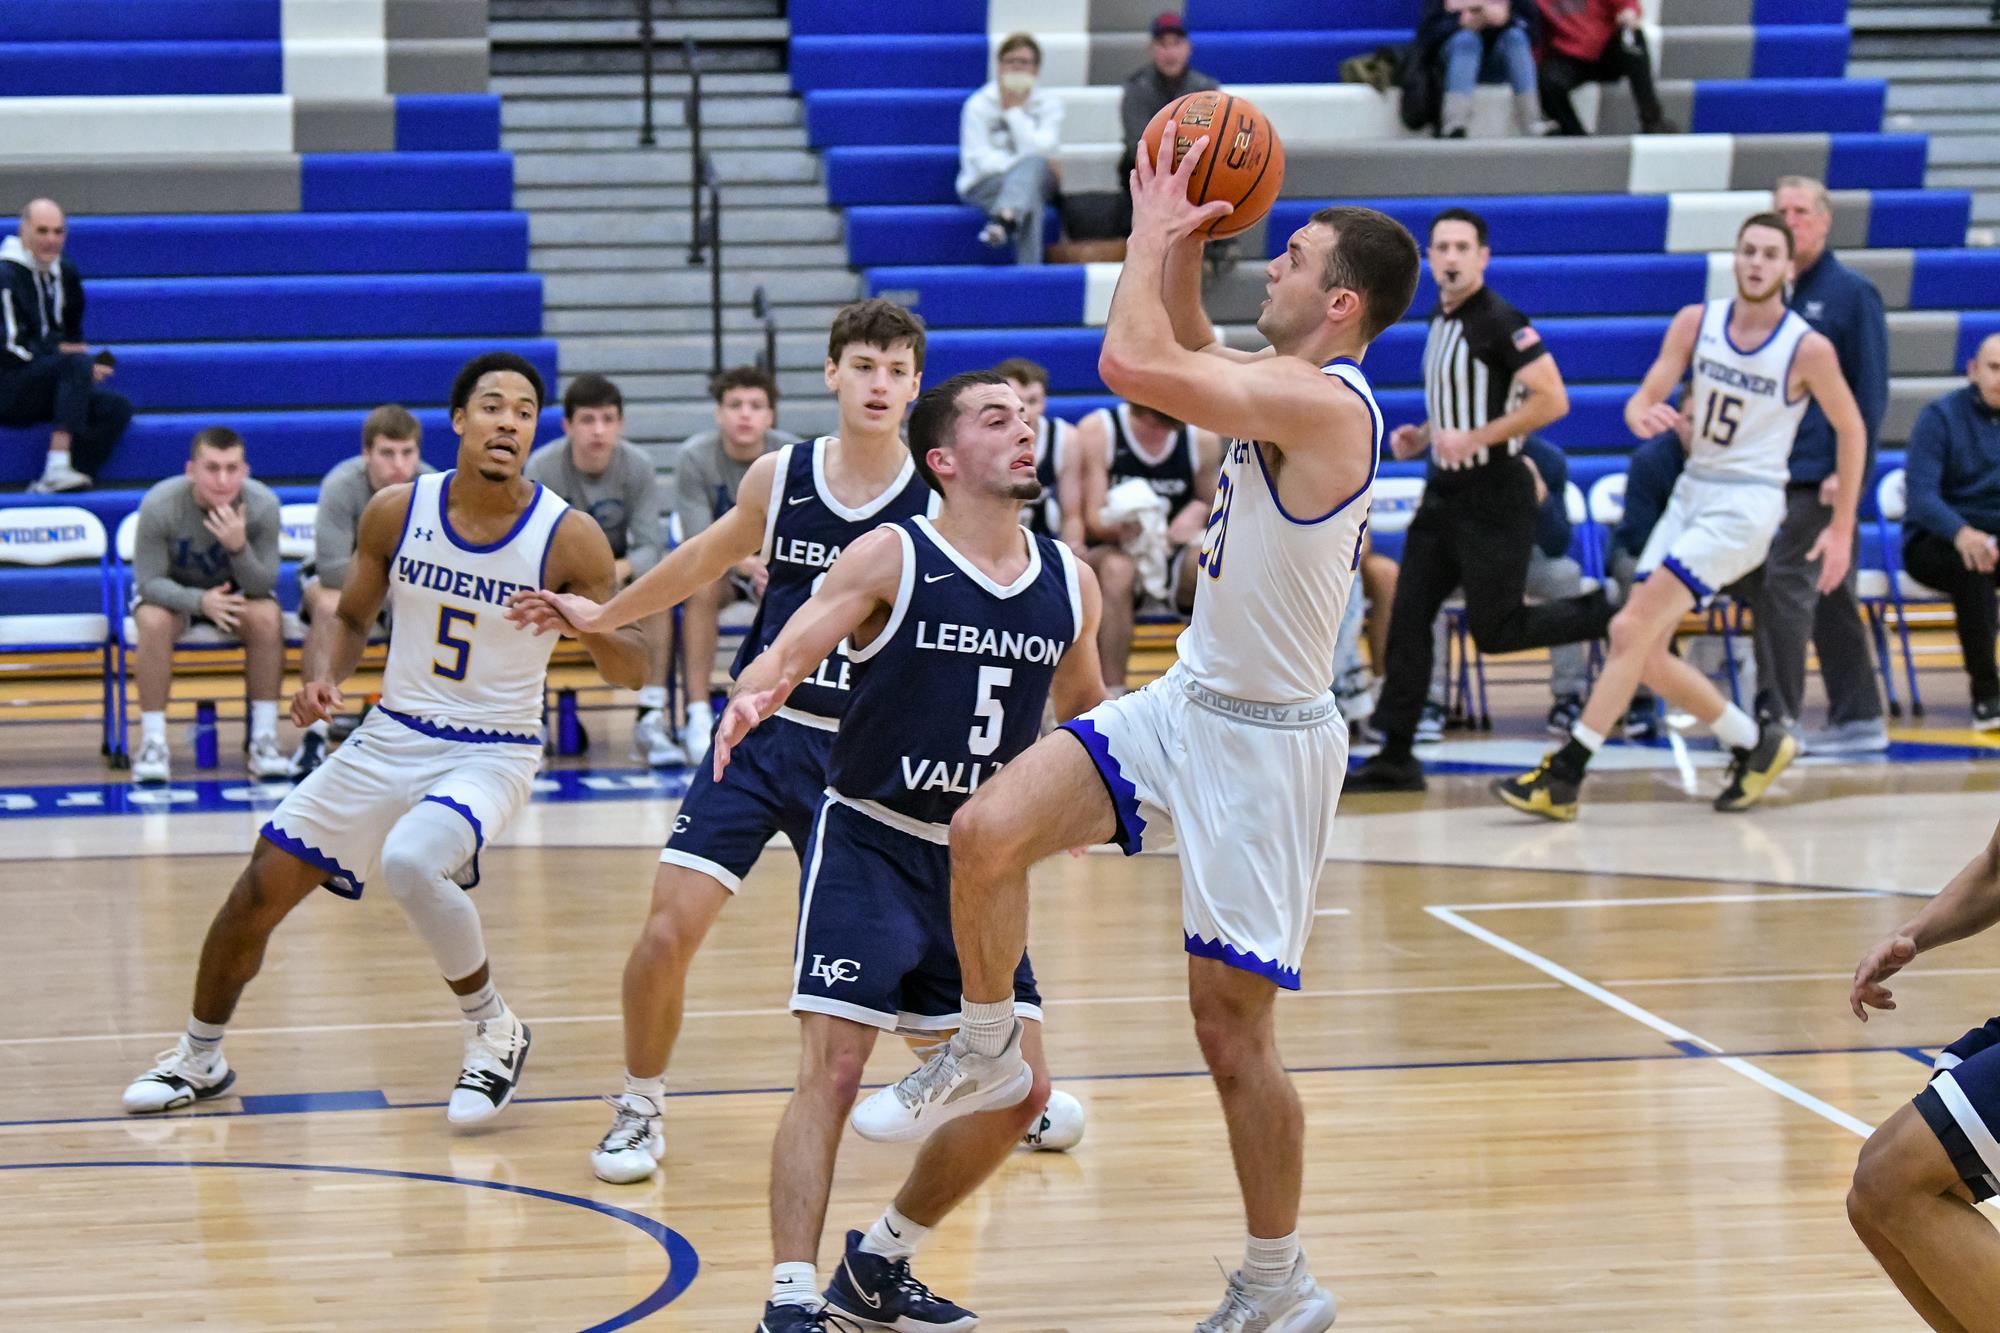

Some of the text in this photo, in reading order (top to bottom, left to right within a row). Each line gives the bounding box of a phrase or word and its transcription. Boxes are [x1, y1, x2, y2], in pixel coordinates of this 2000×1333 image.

[1702, 387, 1744, 447] 15
[775, 536, 841, 568] LEBA
[399, 556, 537, 608] WIDENE
[432, 603, 479, 683] 5
[915, 620, 1065, 667] LEBANON
[967, 665, 1013, 756] 5
[901, 755, 1004, 795] VALL
[809, 954, 861, 988] LVC
